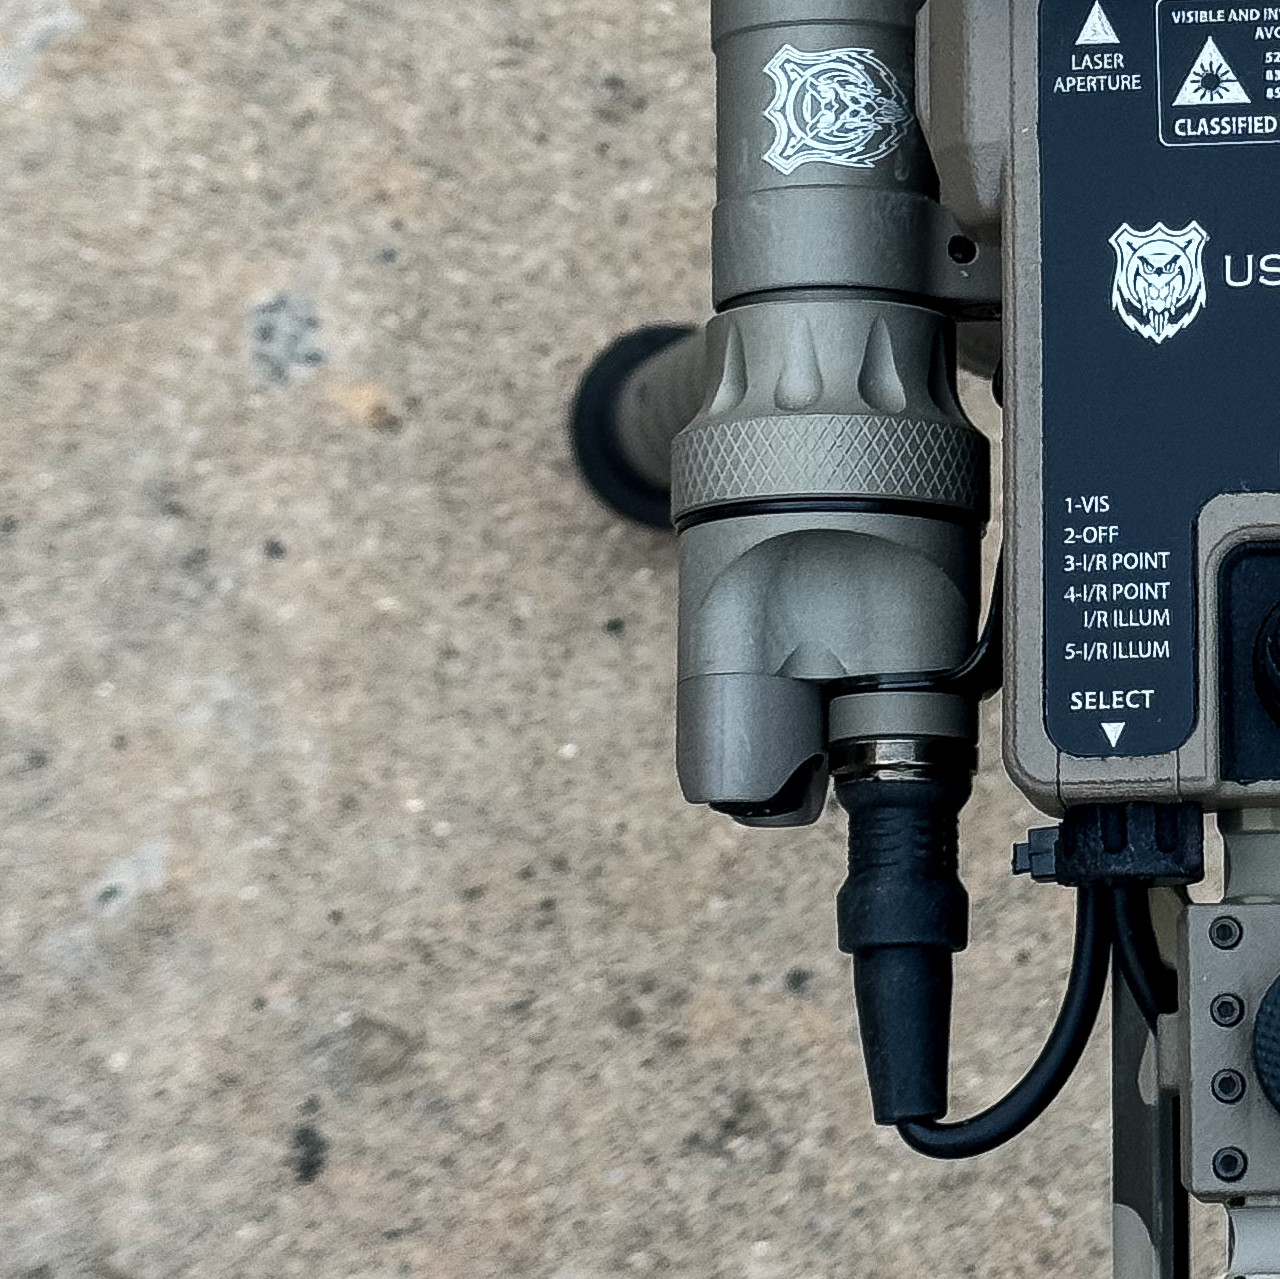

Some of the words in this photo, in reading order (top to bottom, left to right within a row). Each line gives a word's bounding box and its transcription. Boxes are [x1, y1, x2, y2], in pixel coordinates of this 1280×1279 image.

[1171, 9, 1226, 24] VISIBLE
[1227, 8, 1261, 22] AND
[1071, 52, 1125, 71] LASER
[1053, 74, 1142, 93] APERTURE
[1174, 115, 1278, 137] CLASSIFIED
[1065, 495, 1110, 514] 1-VIS
[1063, 525, 1119, 544] 2-OFF
[1063, 553, 1108, 573] 3-I/R
[1112, 551, 1171, 571] POINT
[1063, 583, 1108, 603] 4-I/R
[1112, 581, 1171, 601] POINT
[1083, 610, 1109, 629] I/R
[1113, 608, 1171, 629] ILLUM
[1064, 641, 1109, 662] 5-I/R
[1112, 640, 1170, 660] ILLUM
[1070, 689, 1155, 711] SELECT
